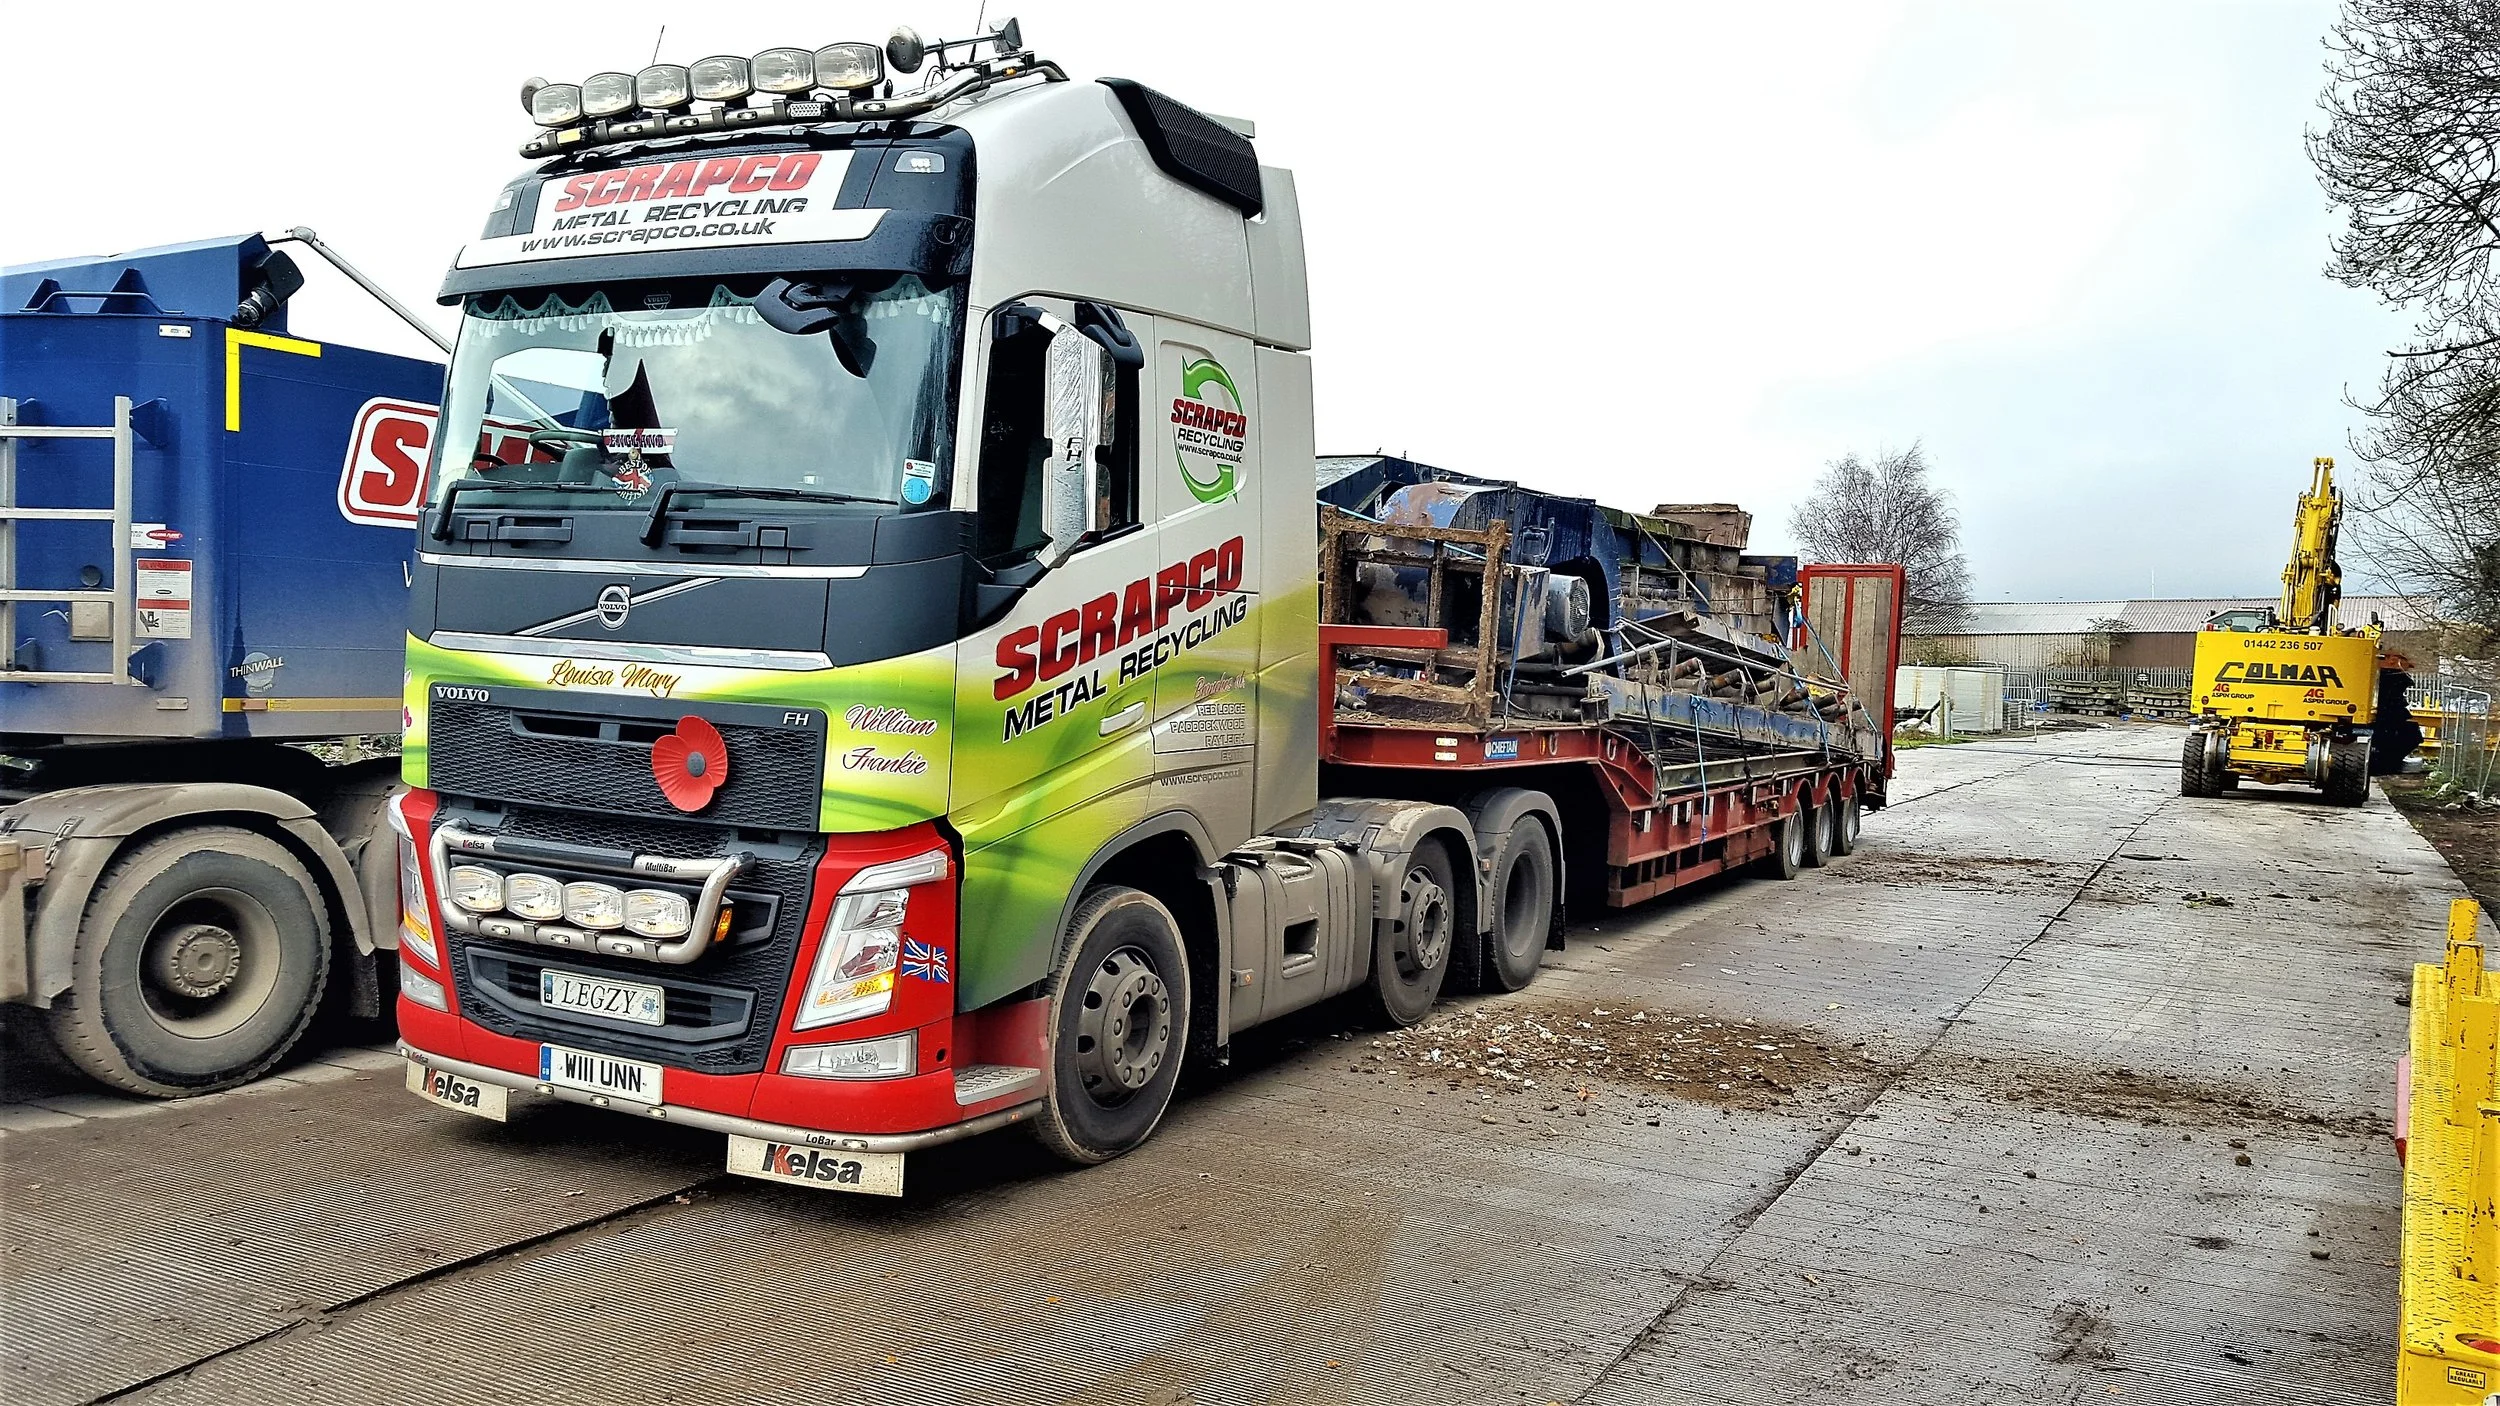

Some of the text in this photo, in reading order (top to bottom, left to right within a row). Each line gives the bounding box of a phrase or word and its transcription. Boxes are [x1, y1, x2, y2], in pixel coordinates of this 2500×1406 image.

[555, 153, 822, 212] SCRAPCO
[552, 198, 808, 231] METAL RECYCLING
[522, 218, 776, 252] www.scrapco.co.uk
[1171, 398, 1247, 438] SCRAPCO
[609, 434, 663, 448] ENGLAND
[1178, 427, 1244, 453] RECYCLING
[618, 460, 641, 475] BEST
[599, 603, 627, 611] VOLVO
[993, 535, 1244, 701] SCRAPCO
[2244, 640, 2323, 650] 01442 236 507
[230, 656, 284, 678] THINWALL
[547, 659, 682, 698] Louisa Mary
[1003, 594, 1247, 743] METAL RECYCLING
[2215, 662, 2344, 688] COLMAR
[435, 686, 489, 702] VOLVO
[2213, 683, 2230, 692] AG
[2304, 688, 2325, 698] AG
[783, 712, 809, 726] FH
[845, 705, 937, 736] William
[842, 748, 927, 775] Frankie
[462, 839, 485, 850] Kelsa
[645, 861, 677, 873] MultiBar
[561, 980, 637, 1014] LEGZY
[421, 1067, 481, 1108] Kelsa
[601, 1060, 641, 1092] UNN
[806, 1133, 836, 1146] LoBar
[762, 1143, 862, 1184] Kelsa
[2456, 1371, 2477, 1379] GREASE
